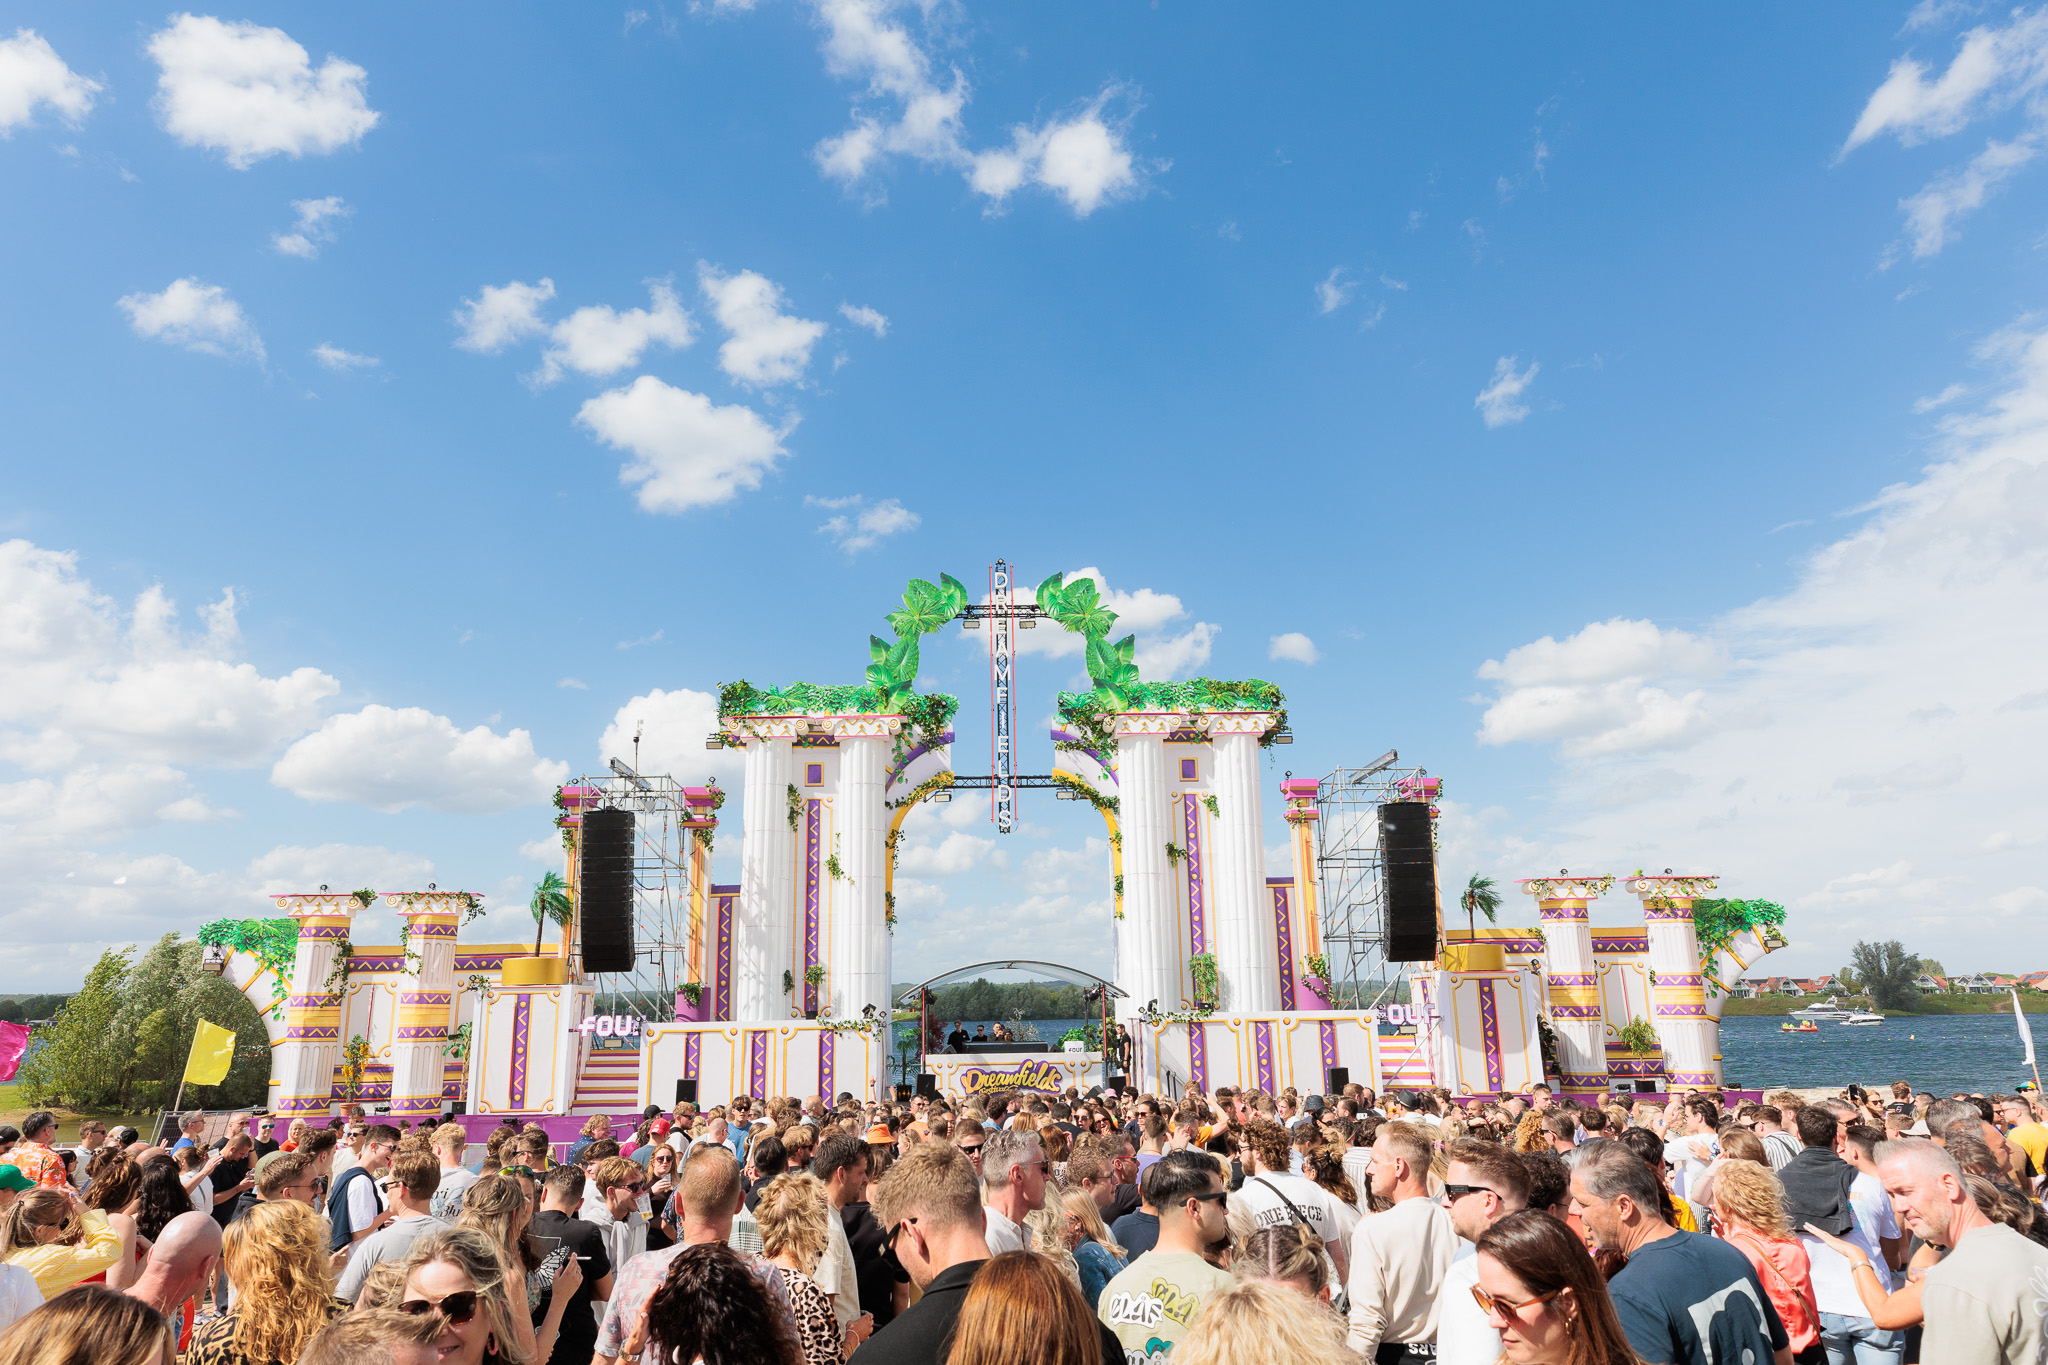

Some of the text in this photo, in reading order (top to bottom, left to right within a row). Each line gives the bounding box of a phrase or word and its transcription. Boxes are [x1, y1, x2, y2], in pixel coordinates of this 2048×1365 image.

[994, 572, 1011, 828] DREAMFIELDS
[960, 1060, 1062, 1094] Dreamfields
[1254, 1207, 1285, 1227] ONE
